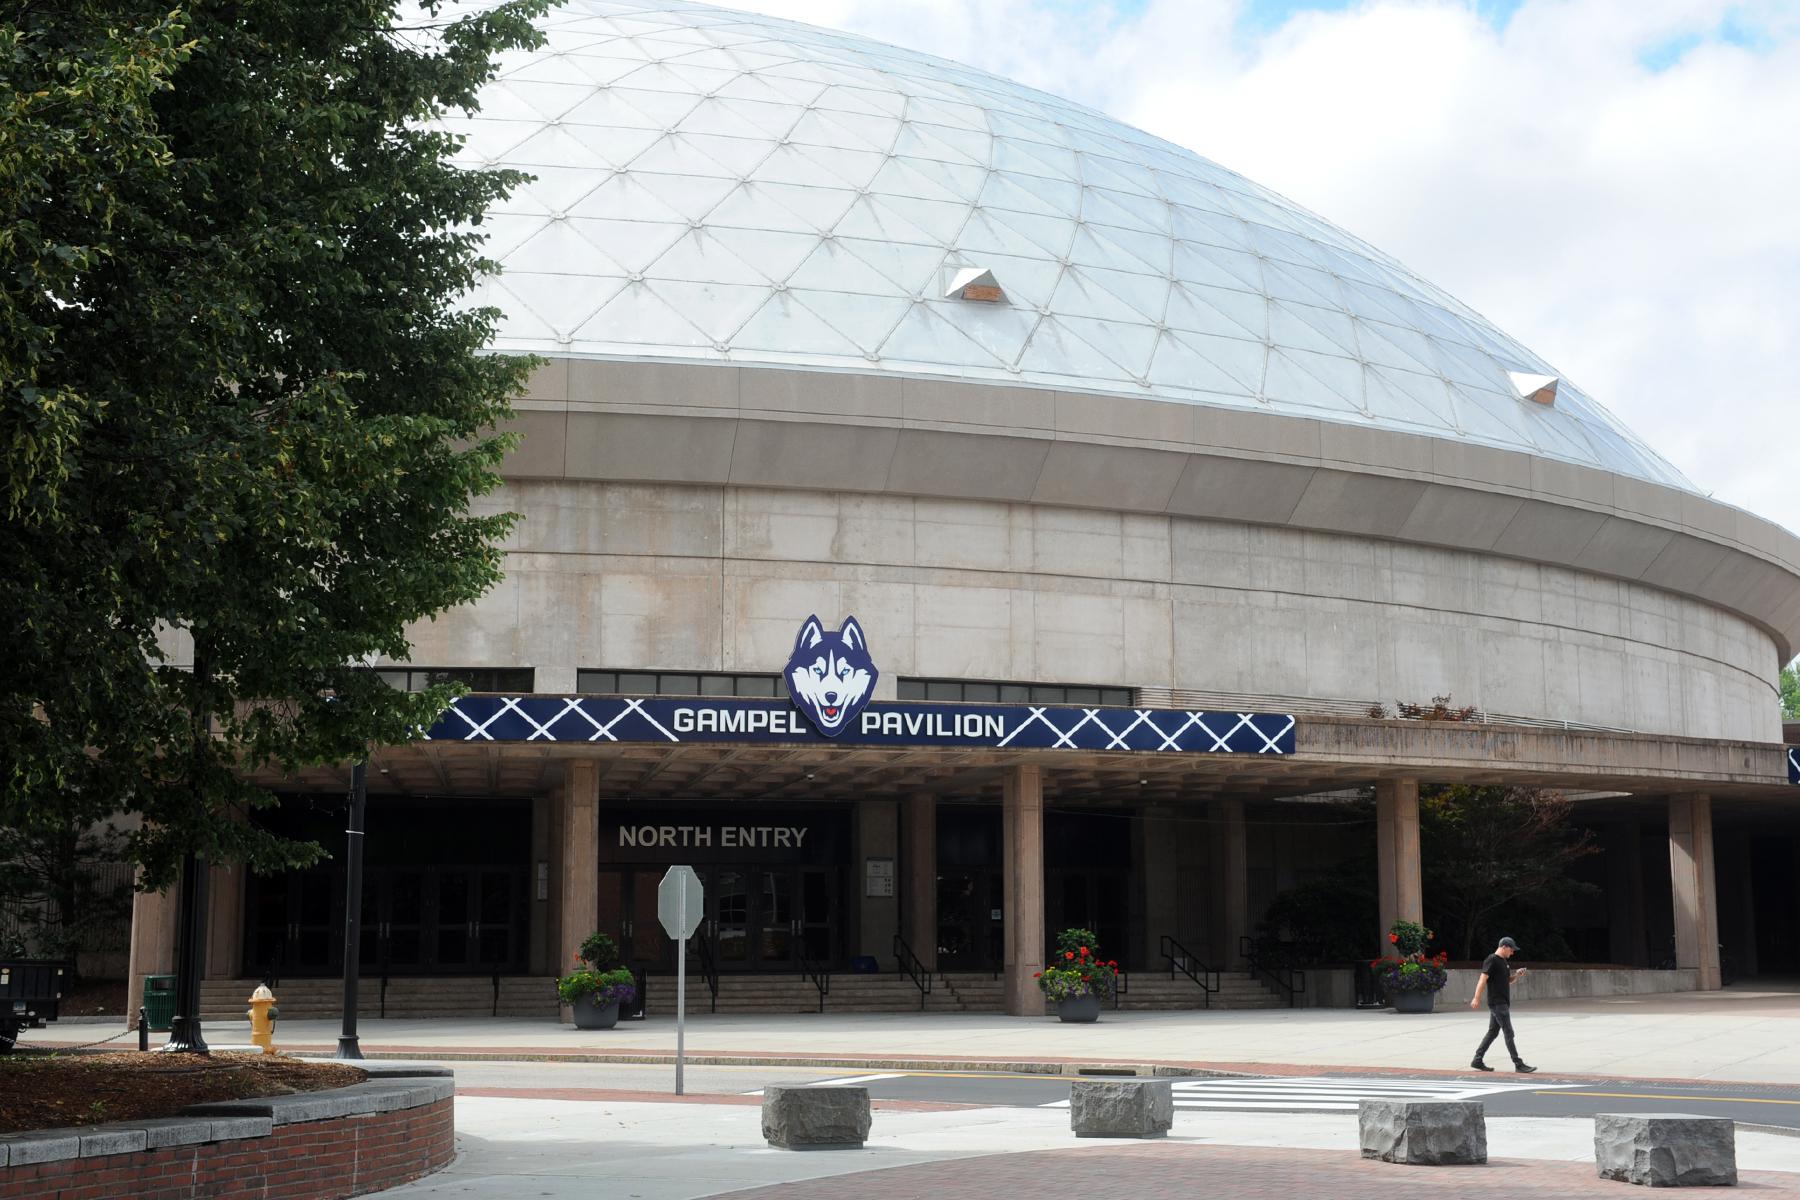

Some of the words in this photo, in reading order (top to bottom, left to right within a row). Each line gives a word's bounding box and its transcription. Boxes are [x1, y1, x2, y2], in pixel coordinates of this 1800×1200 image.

[673, 708, 807, 734] GAMPEL
[861, 712, 1004, 738] PAVILION
[619, 825, 711, 847] NORTH
[721, 826, 808, 848] ENTRY
